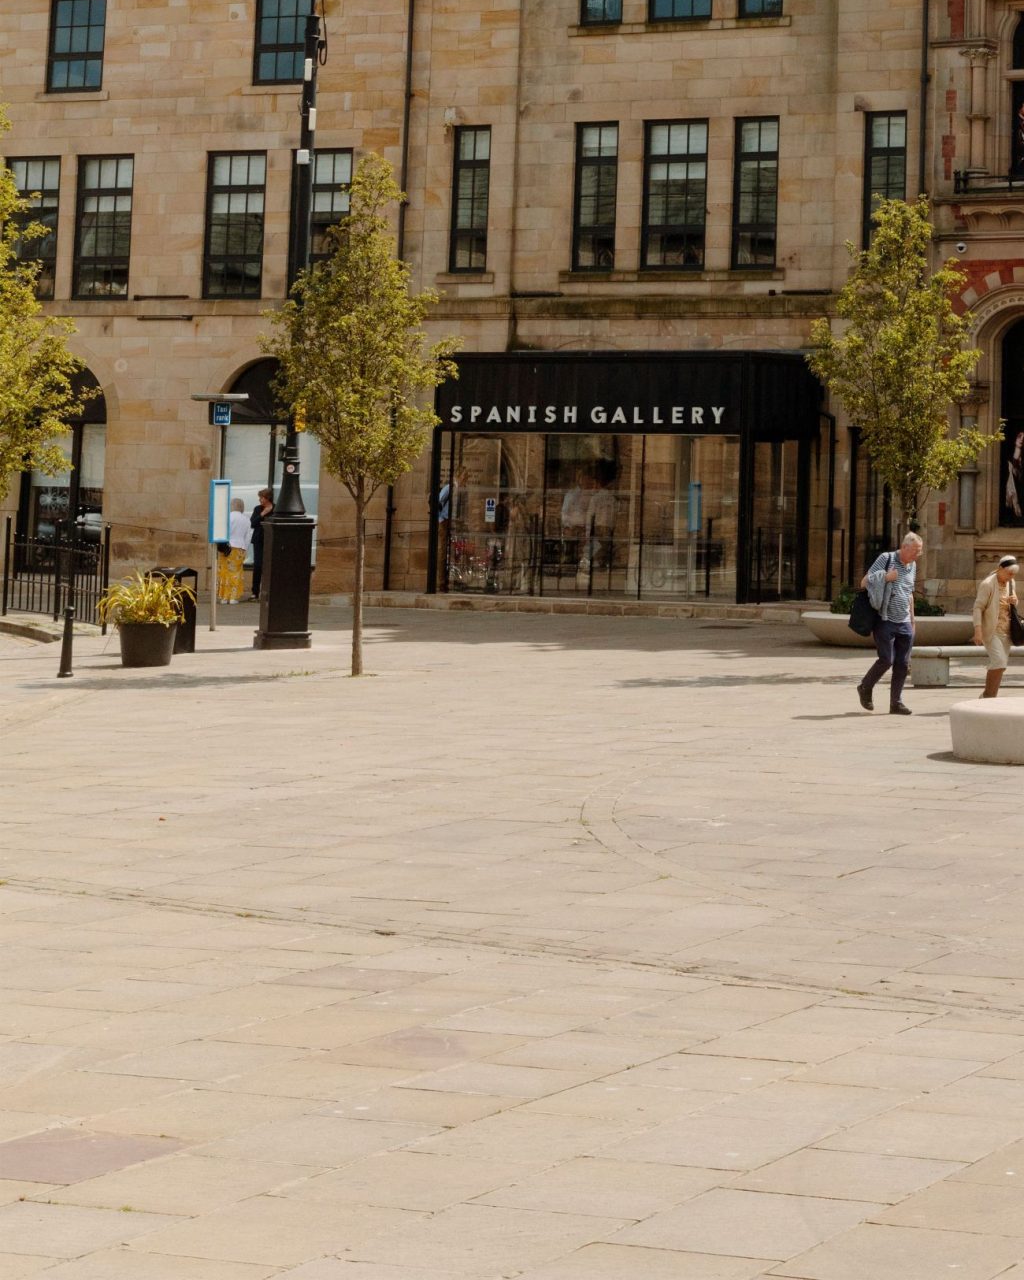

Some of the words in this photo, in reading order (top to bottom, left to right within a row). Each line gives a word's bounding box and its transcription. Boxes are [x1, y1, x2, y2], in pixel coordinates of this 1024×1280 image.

[216, 414, 229, 422] rank
[450, 405, 578, 424] SPANISH
[590, 406, 726, 424] GALLERY
